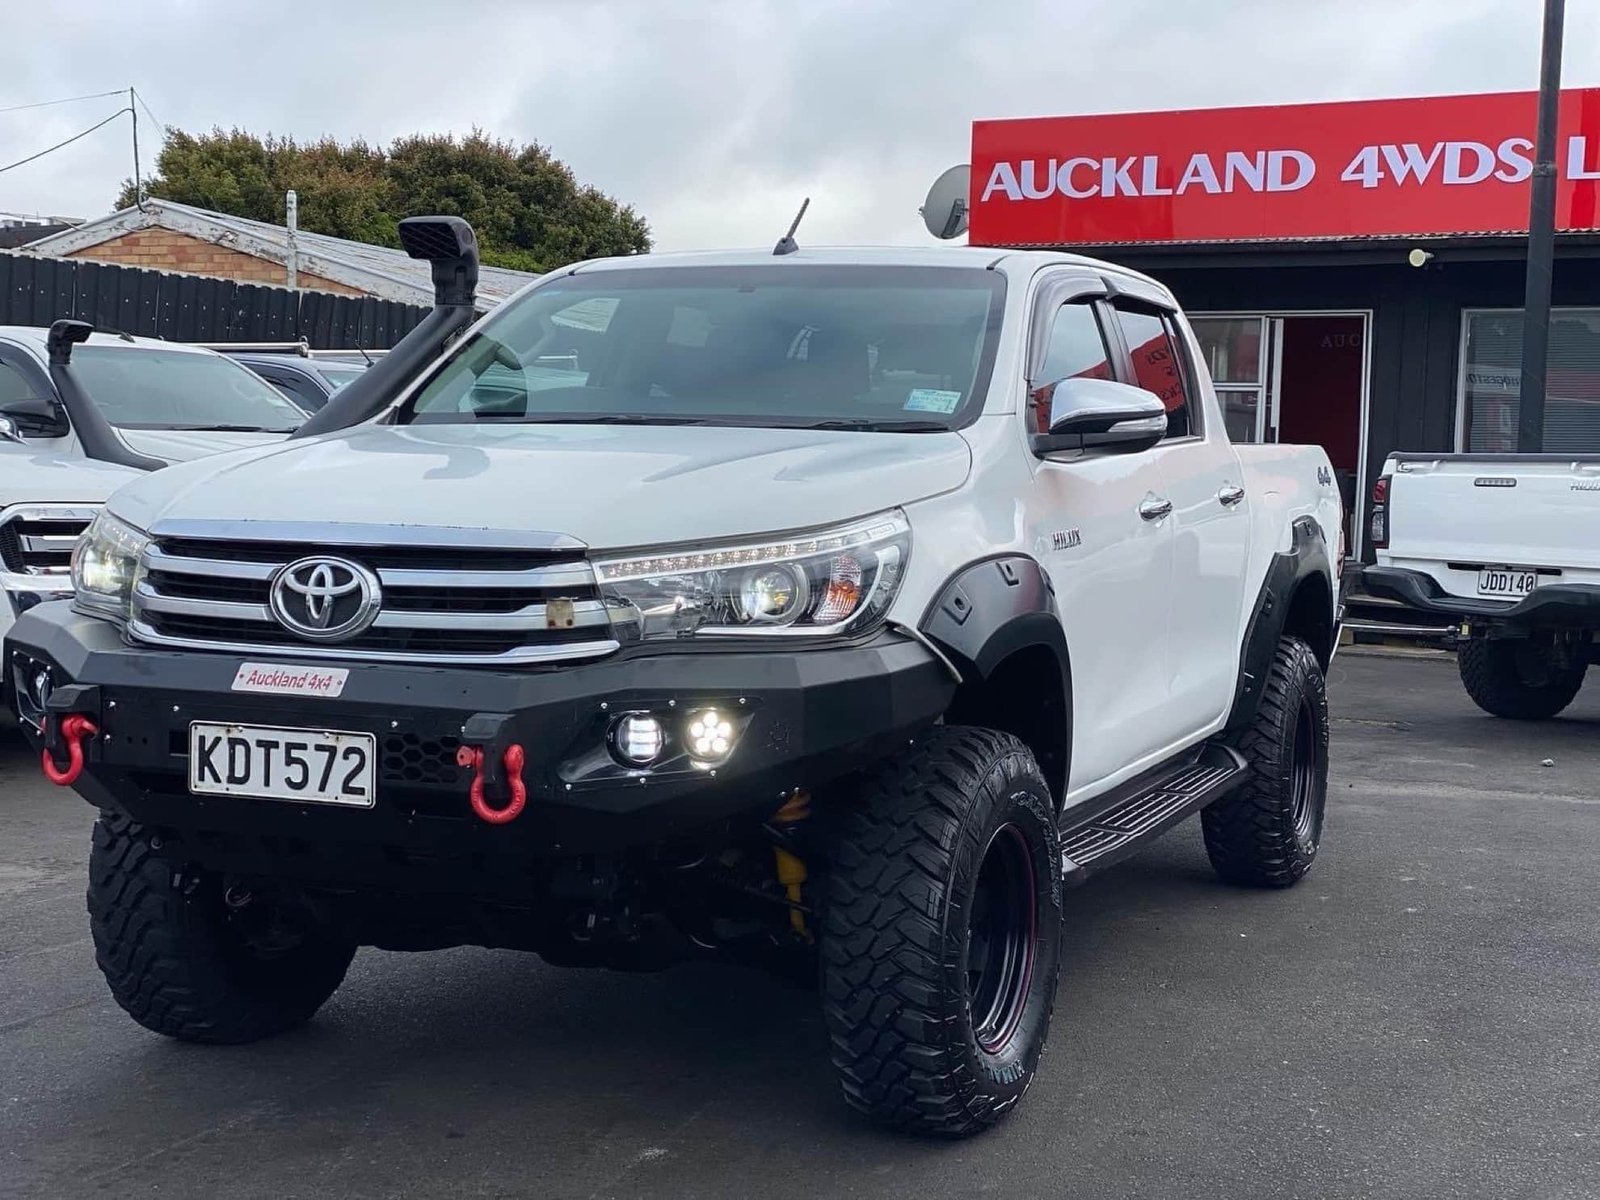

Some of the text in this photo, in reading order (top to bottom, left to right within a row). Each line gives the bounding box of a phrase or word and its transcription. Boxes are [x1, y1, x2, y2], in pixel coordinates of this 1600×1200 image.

[981, 149, 1316, 202] AUCKLAND
[1341, 137, 1535, 189] 4WDS
[1051, 528, 1082, 551] HILUX
[1480, 572, 1534, 593] JDD140
[246, 669, 333, 690] Auckland 4x4
[198, 735, 366, 797] KDT572
